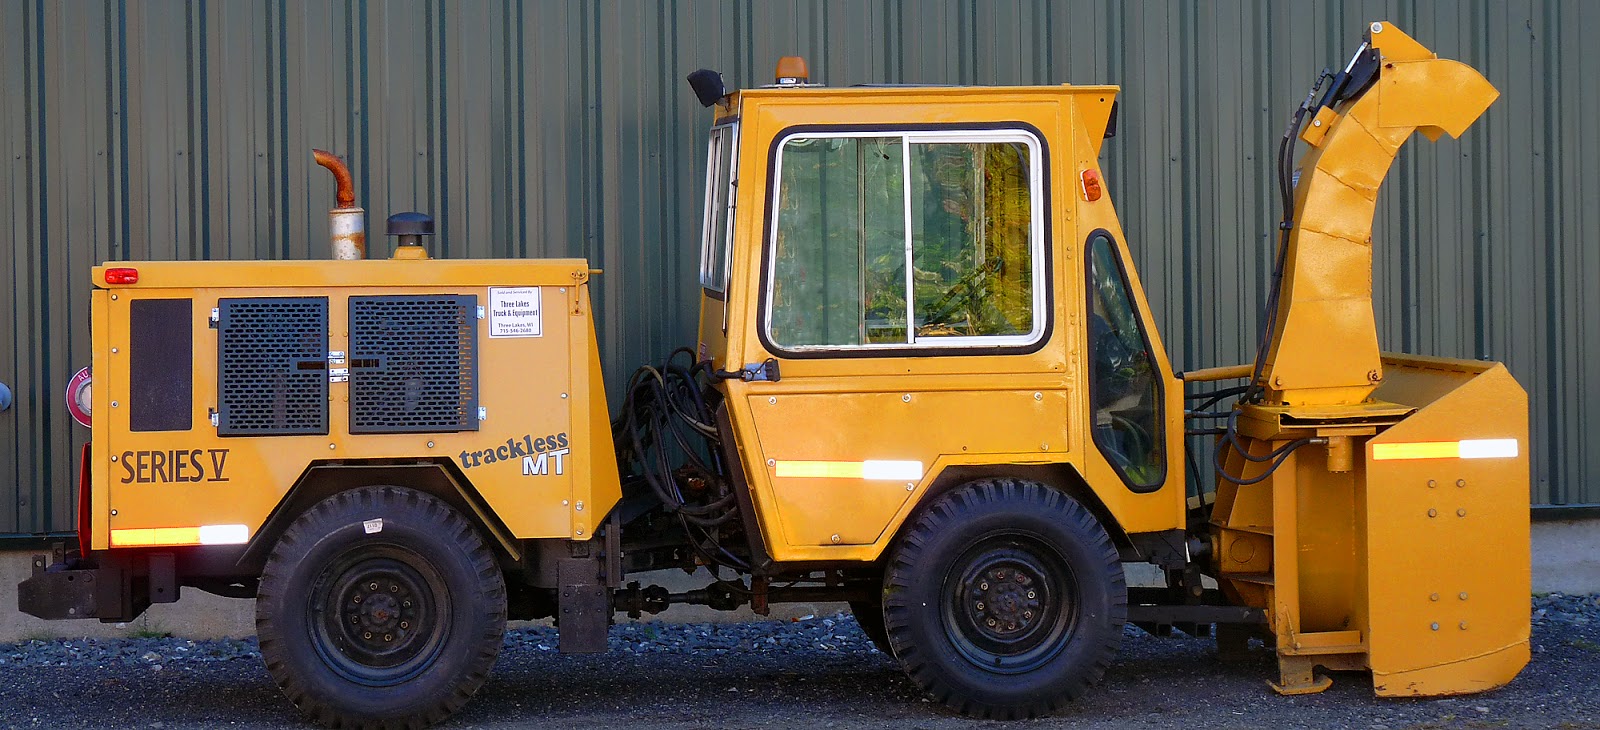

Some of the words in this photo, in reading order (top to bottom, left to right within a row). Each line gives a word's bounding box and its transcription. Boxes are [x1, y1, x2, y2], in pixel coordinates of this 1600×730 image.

[493, 309, 507, 317] Truck
[512, 309, 538, 318] Equipment
[121, 449, 203, 484] SERIES
[207, 448, 230, 482] V
[459, 431, 569, 469] trackless
[522, 448, 570, 476] MT
